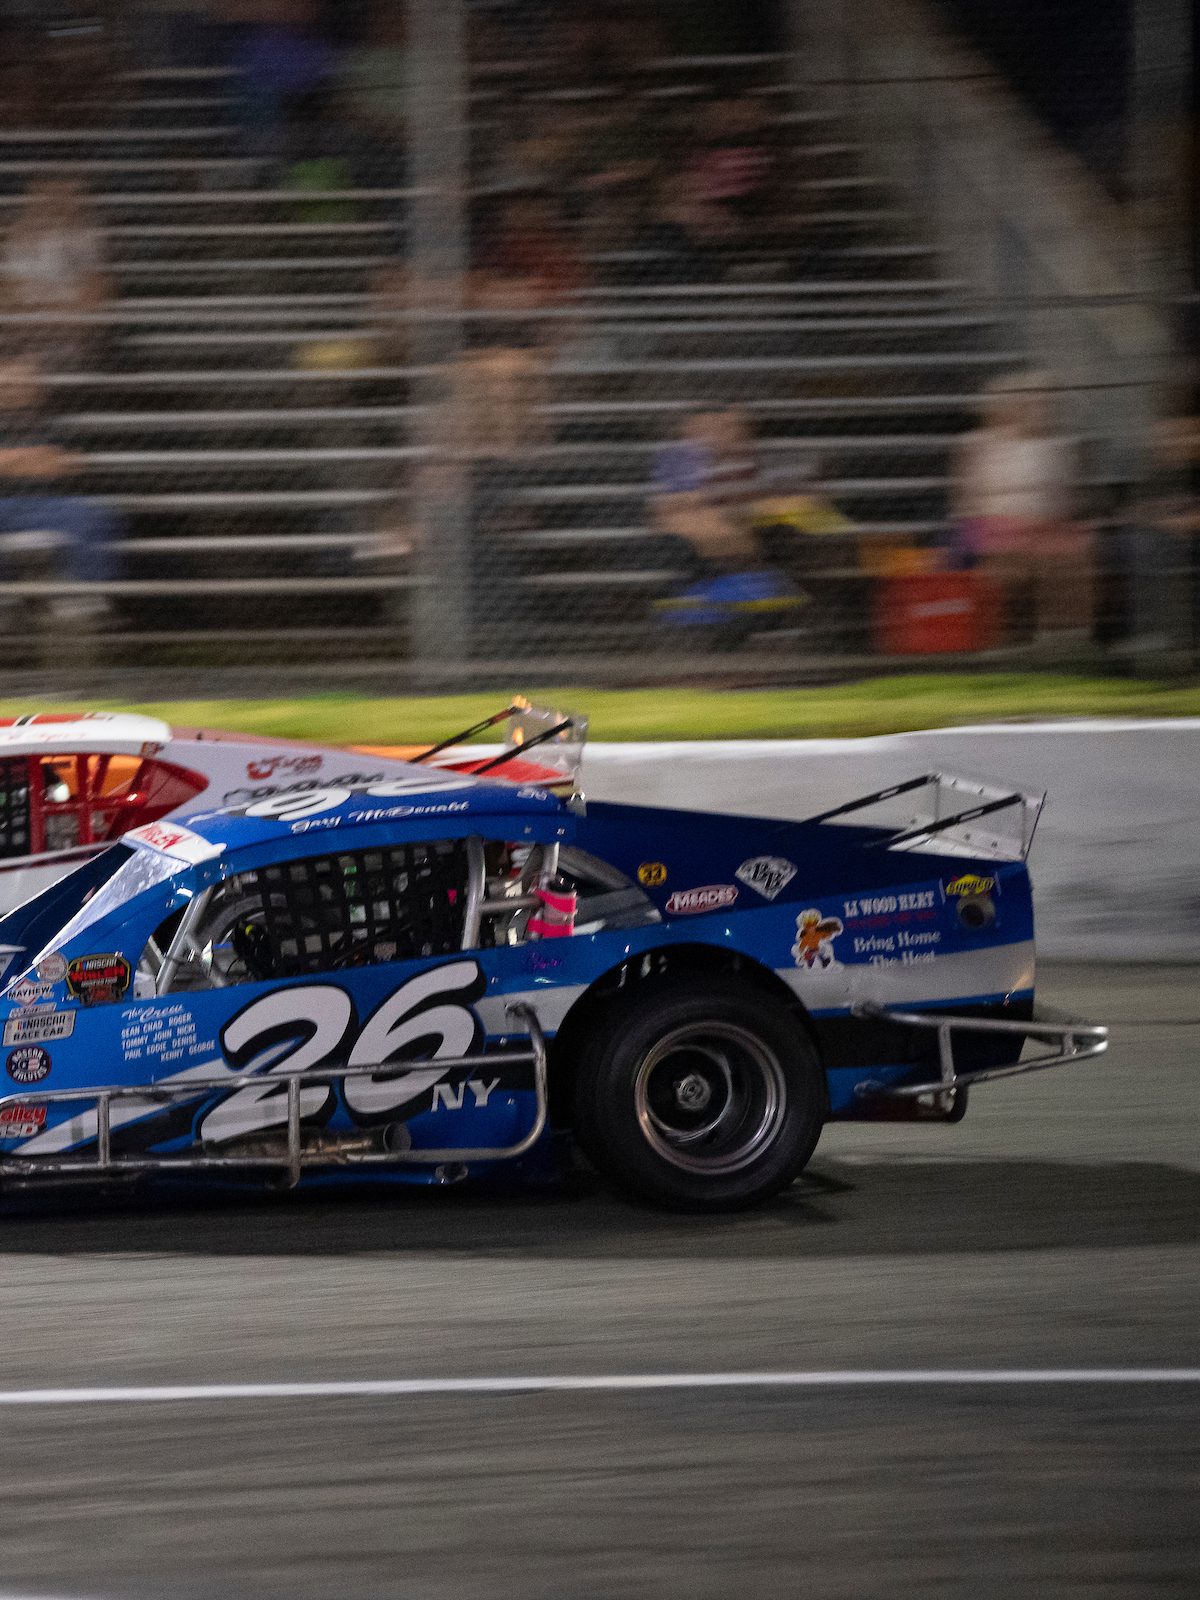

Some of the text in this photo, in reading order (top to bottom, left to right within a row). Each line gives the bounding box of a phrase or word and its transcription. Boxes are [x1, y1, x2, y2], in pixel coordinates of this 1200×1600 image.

[860, 895, 897, 915] WOOD
[897, 890, 935, 911] HEAT
[854, 930, 942, 953] Bring Home
[8, 985, 50, 999] MAYHEW
[13, 1026, 64, 1041] RACE CAR
[26, 1015, 66, 1030] NASCAR
[121, 1012, 192, 1039] SEAN CHAD ROGER
[122, 1035, 149, 1050] TOMMY
[153, 1028, 172, 1043] JOHN
[125, 1033, 197, 1061] PAUL EDDIE DENISE
[160, 1039, 215, 1063] KENNY GEORGE
[200, 960, 501, 1145] 26 NY
